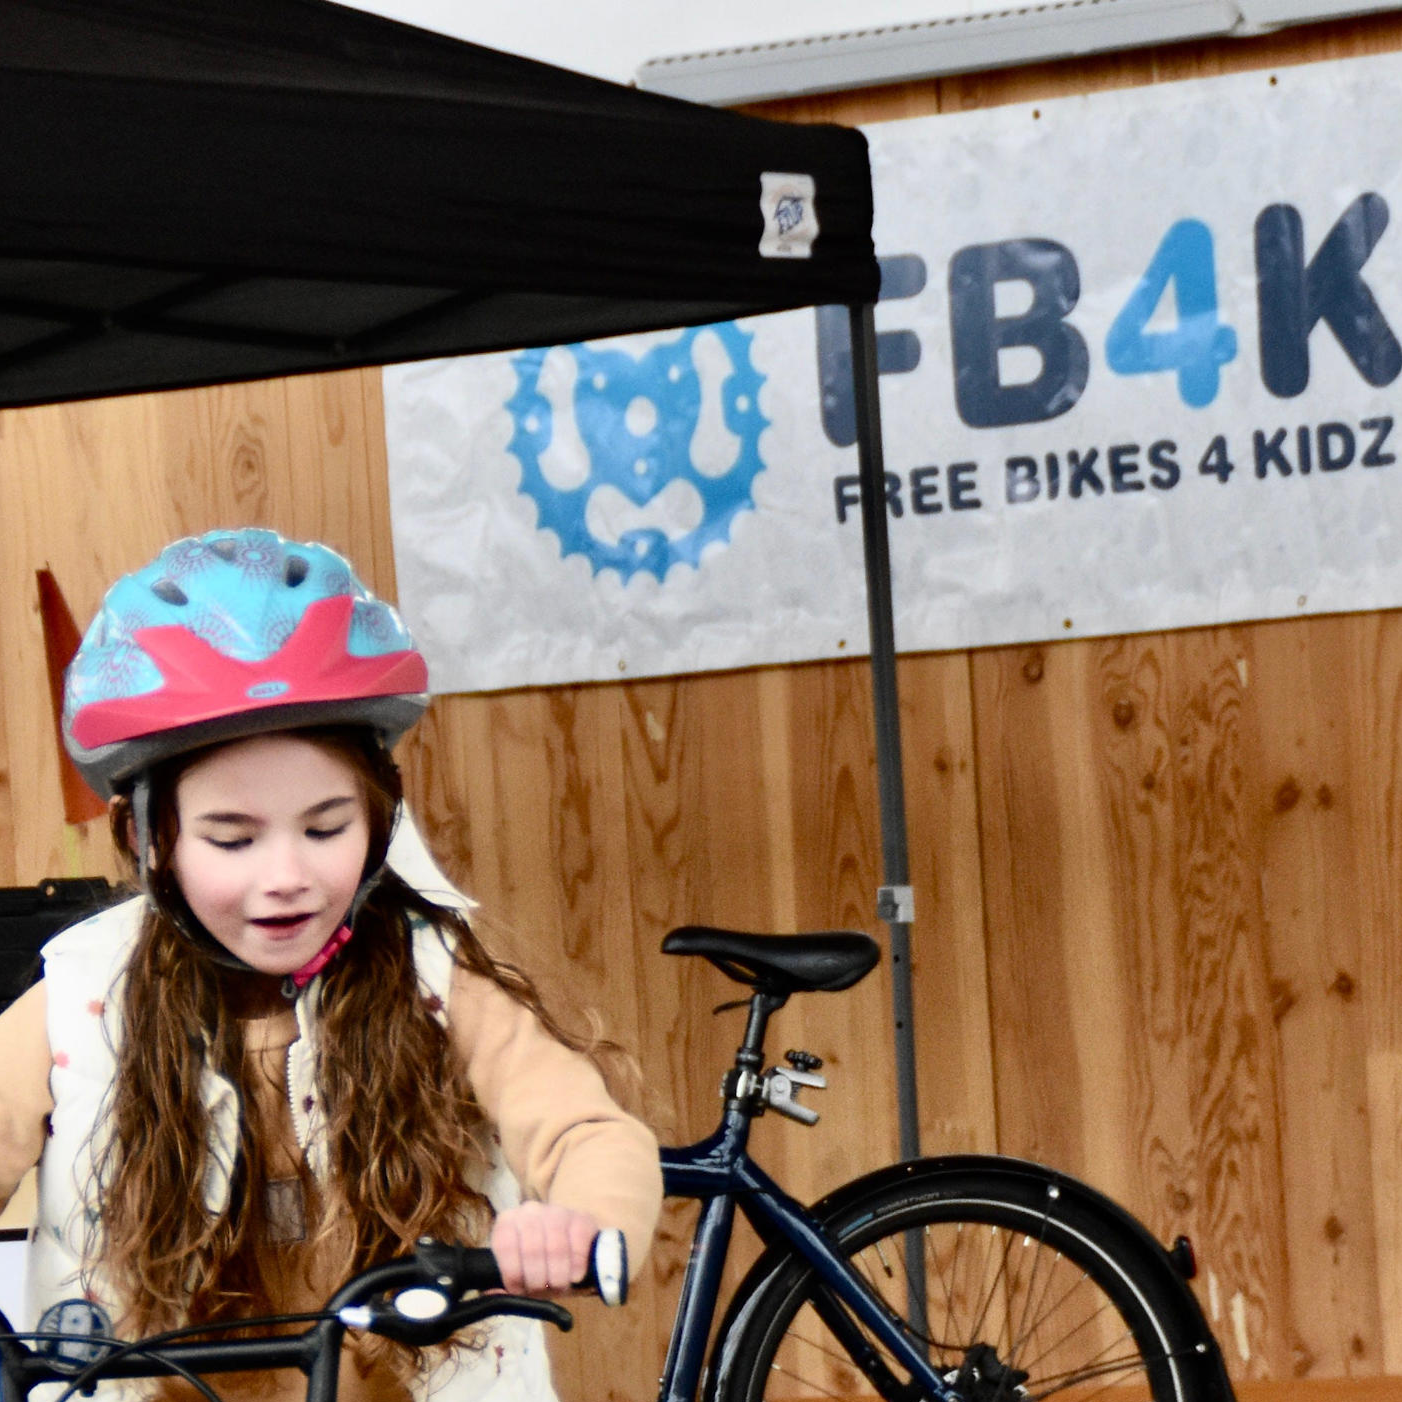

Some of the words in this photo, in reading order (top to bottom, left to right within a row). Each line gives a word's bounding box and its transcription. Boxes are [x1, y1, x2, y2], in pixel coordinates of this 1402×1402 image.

[1004, 439, 1182, 504] BIKES
[1198, 433, 1235, 485] 4
[1252, 415, 1398, 480] KIDZ
